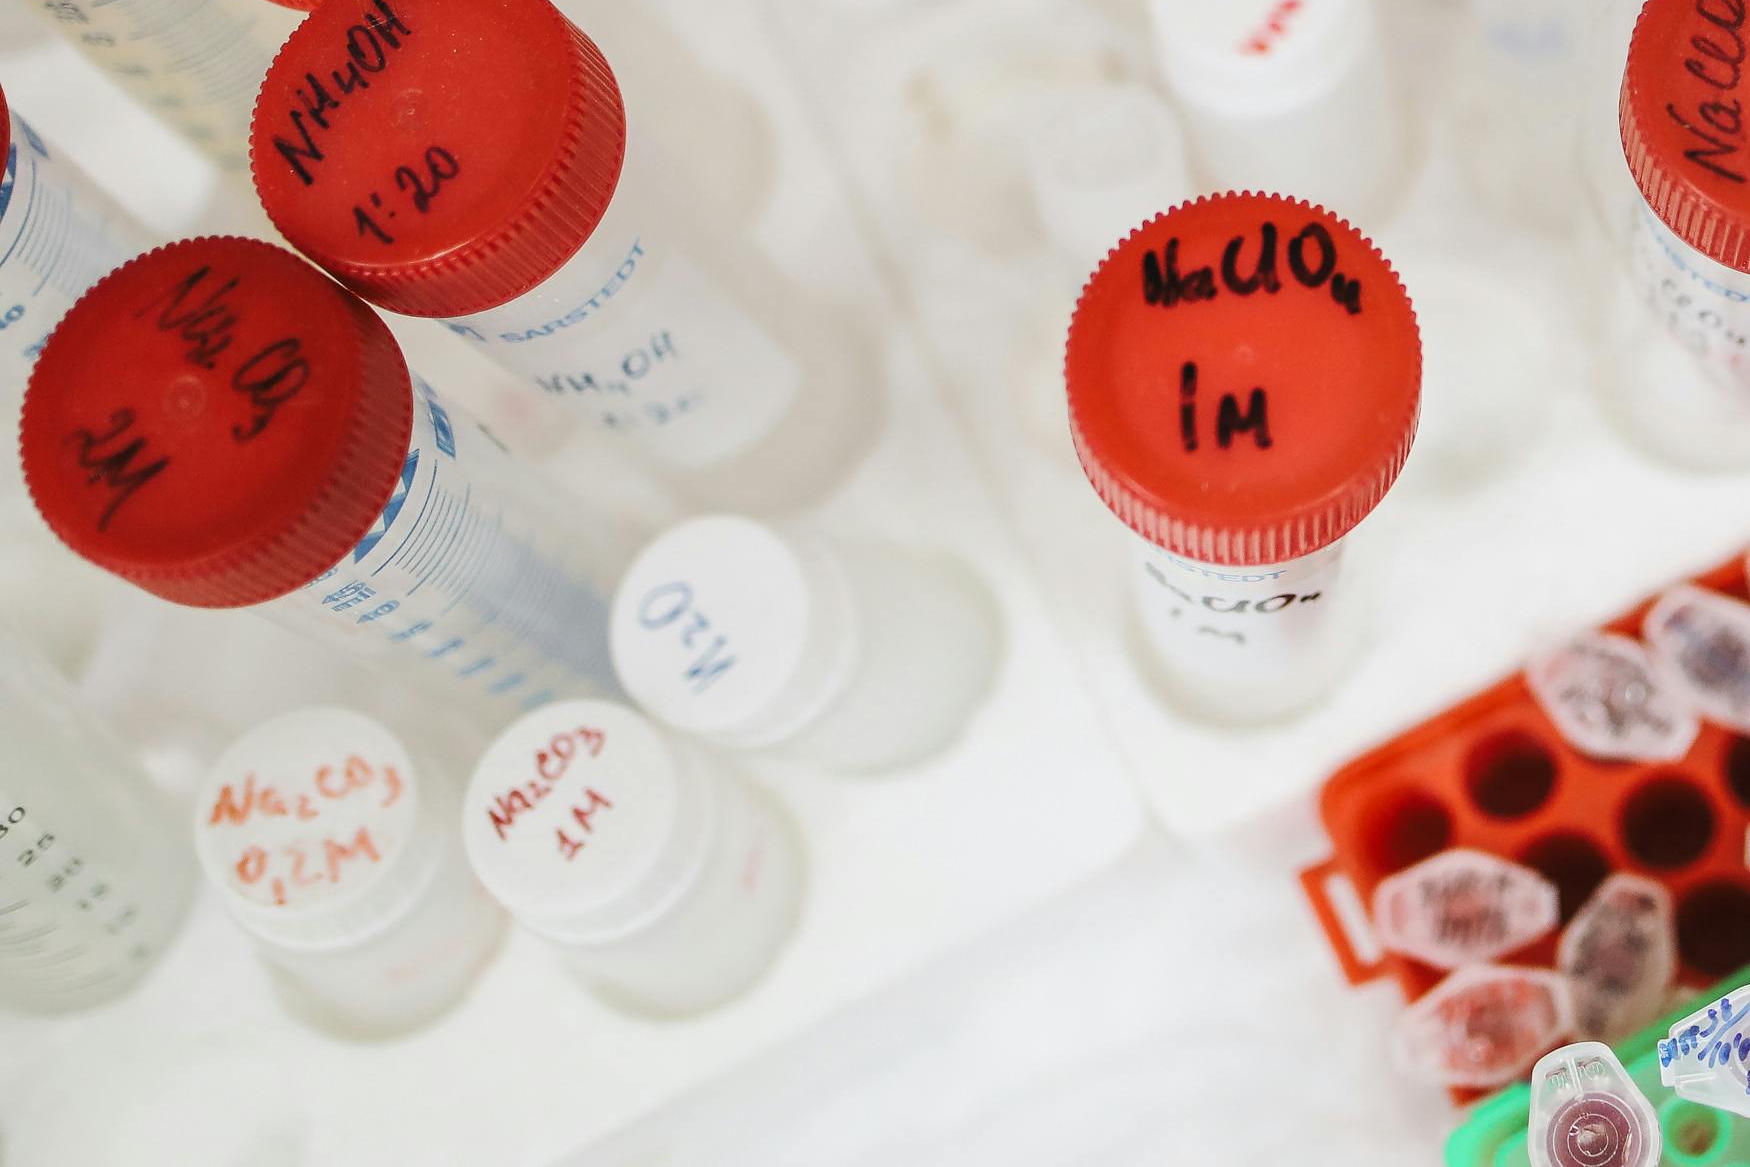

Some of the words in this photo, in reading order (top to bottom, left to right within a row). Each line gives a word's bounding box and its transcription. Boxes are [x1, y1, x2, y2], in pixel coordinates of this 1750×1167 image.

[352, 145, 463, 246] 1:20
[498, 238, 647, 346] SARSTEDT
[236, 827, 382, 906] 0,2M
